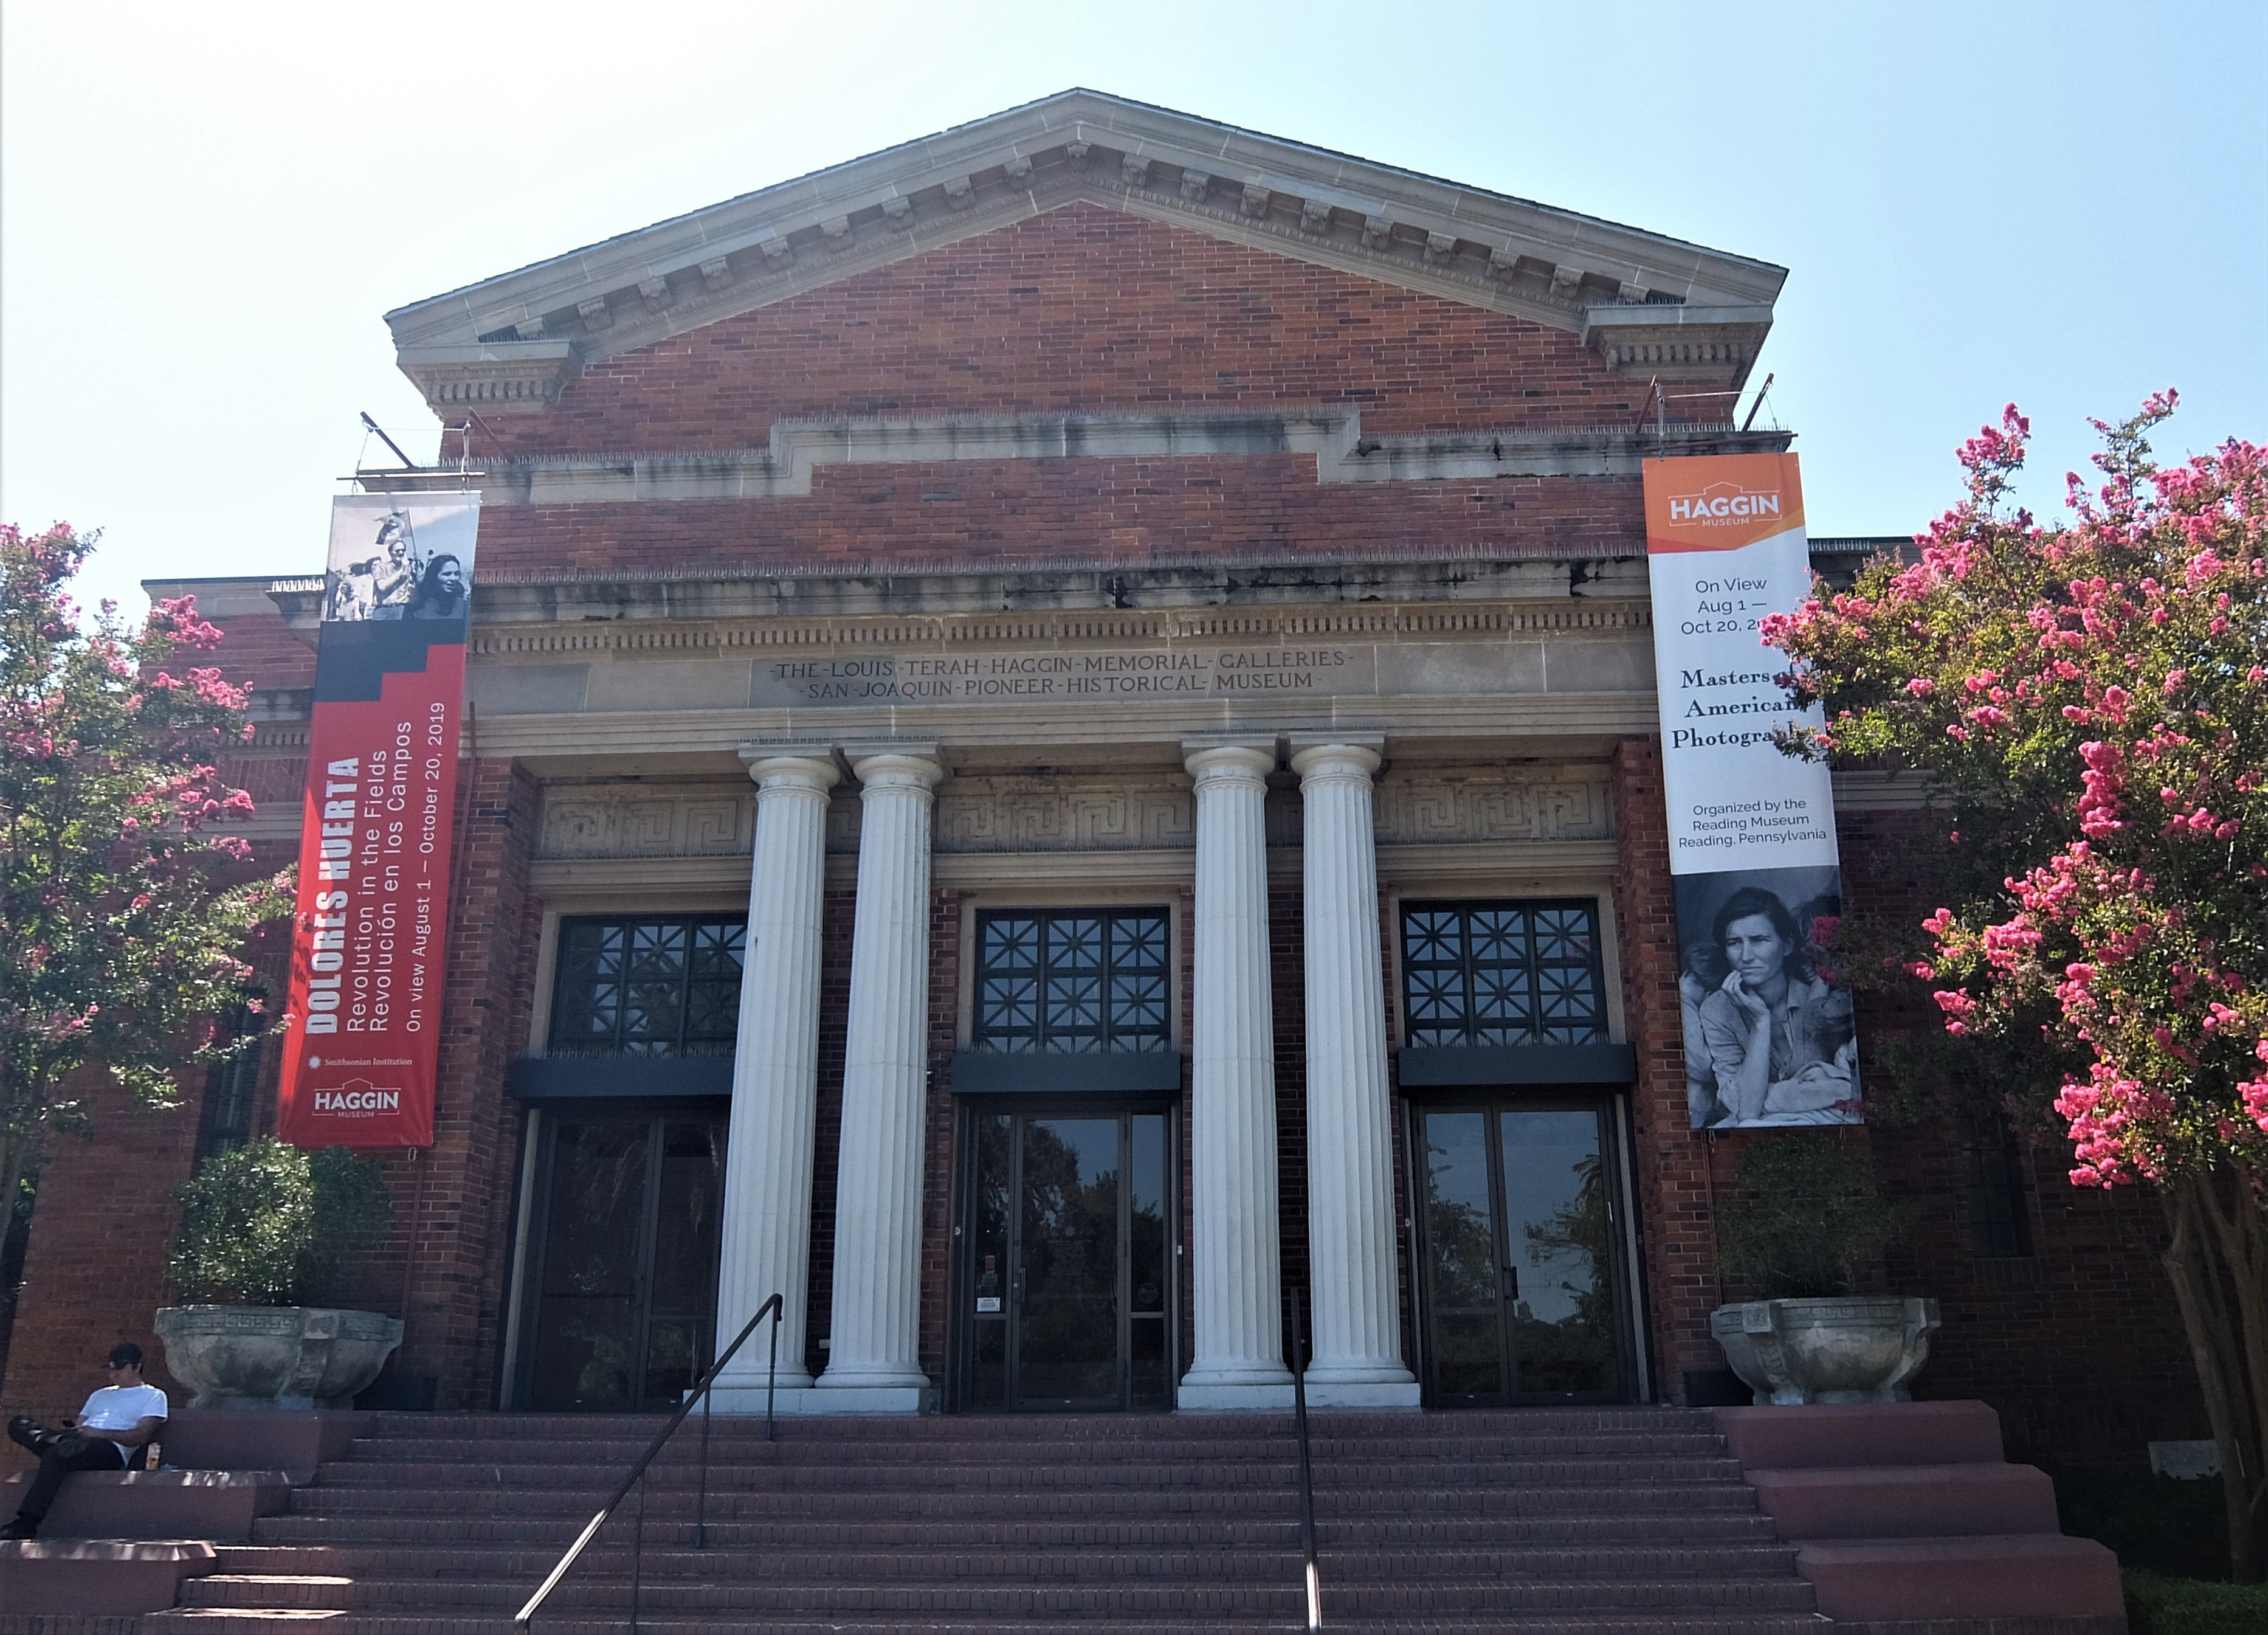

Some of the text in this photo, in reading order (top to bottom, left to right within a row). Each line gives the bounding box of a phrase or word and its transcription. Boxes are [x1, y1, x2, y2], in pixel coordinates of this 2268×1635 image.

[1671, 495, 1778, 519] HAGGIN
[1703, 517, 1749, 526] MUSEUM
[1696, 578, 1766, 593] On View
[1698, 601, 1732, 615] Aug
[1738, 601, 1746, 610] 1
[1681, 620, 1712, 634] Oct
[1717, 621, 1741, 632] 20,
[776, 651, 1344, 678] THE LOUIS TERAH HAGGIN MEMORIAL GALLERIES
[809, 673, 1312, 699] SAN JOAQUIN PIONEER HISTORICAL MUSEUM
[1681, 669, 1770, 688] Masters
[428, 703, 444, 745] 2019
[426, 754, 442, 779] 20,
[1694, 799, 1806, 817] Organized by the
[420, 787, 438, 853] October
[1694, 816, 1809, 831] Reading Museum
[1680, 829, 1826, 848] Reading, Pennsylvania
[370, 722, 412, 1031] Revolución en los Campos
[417, 880, 430, 889] 1
[306, 758, 359, 1033] DOLORES HUERTA
[347, 751, 386, 1031] Revolution in the Fields
[412, 897, 430, 956] August
[409, 964, 424, 1001] view
[407, 1010, 421, 1031] On
[315, 1092, 398, 1110] HAGGIN
